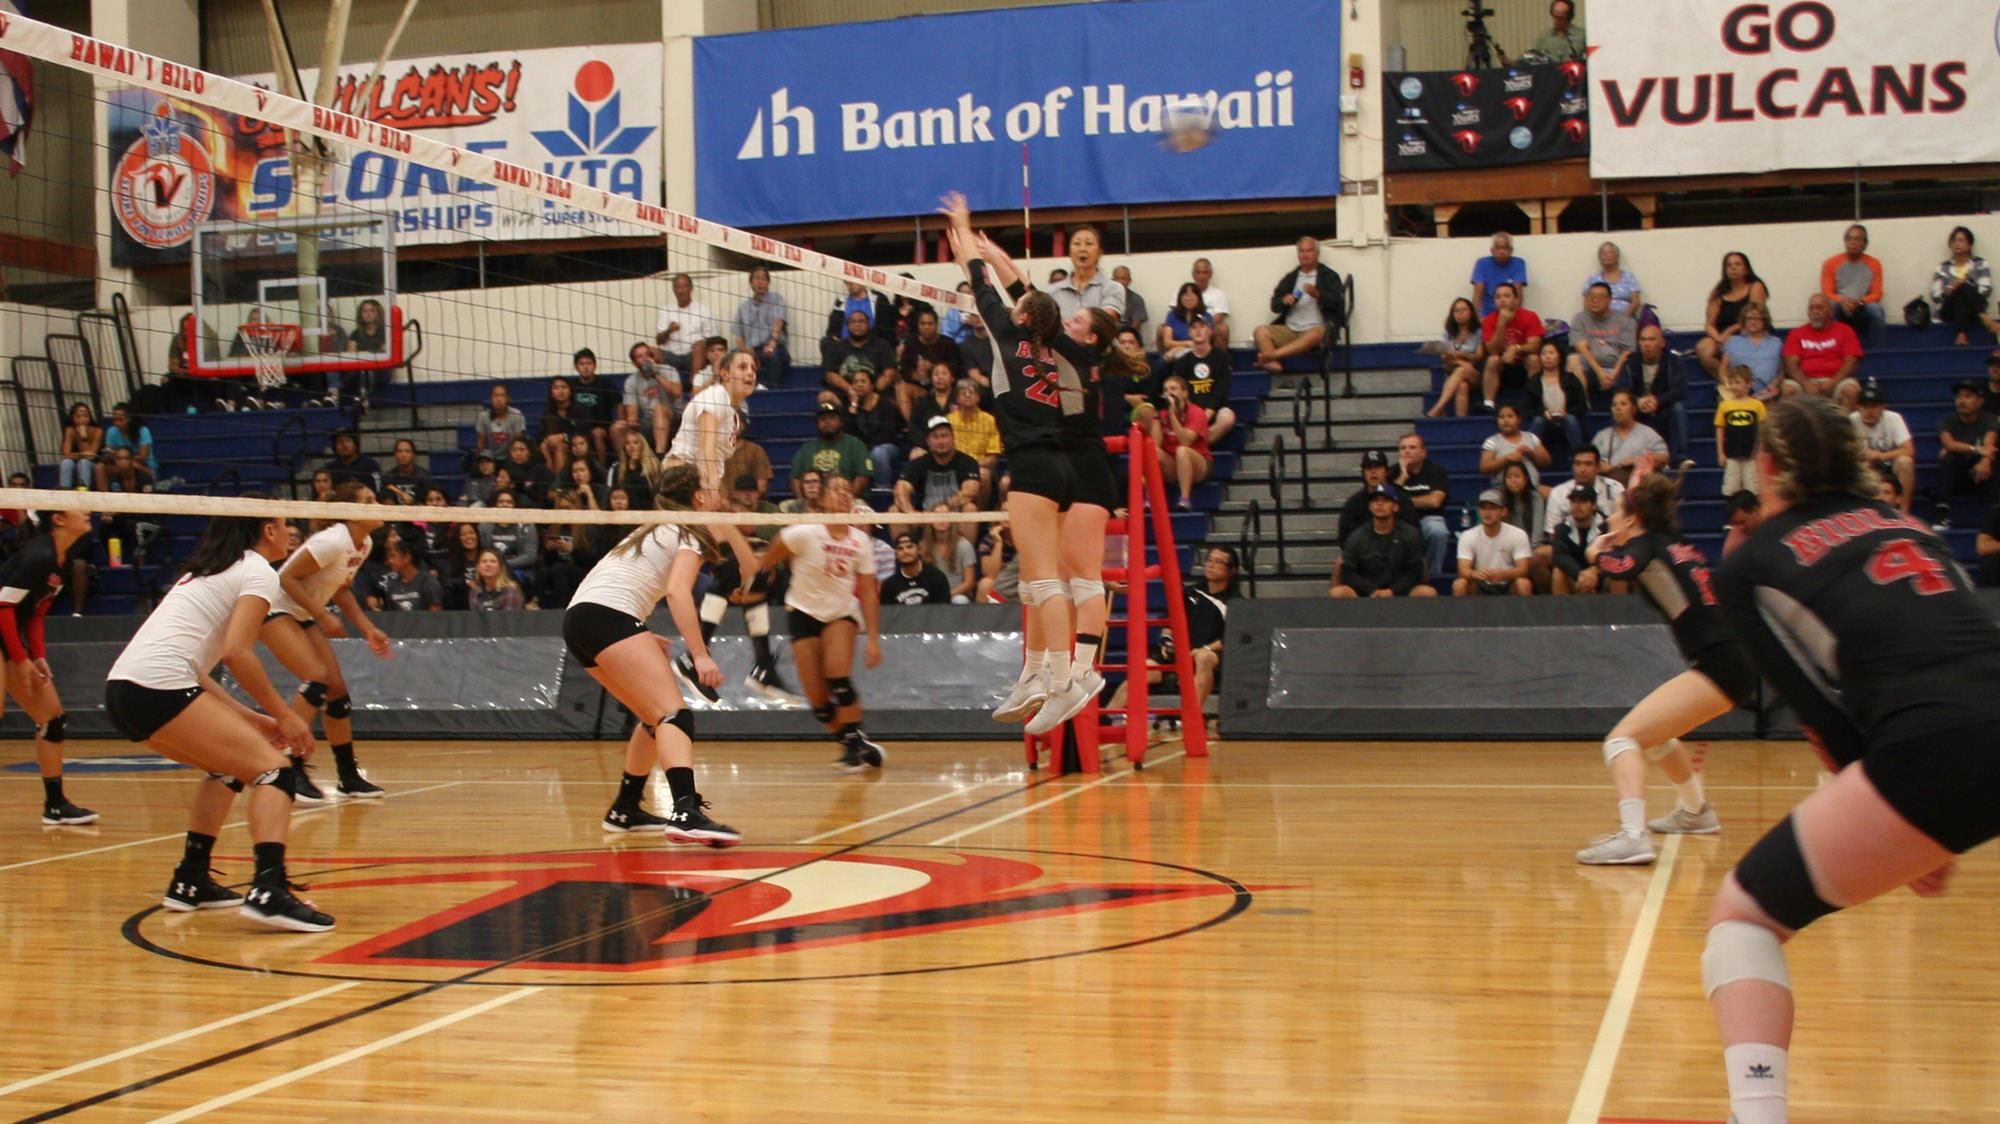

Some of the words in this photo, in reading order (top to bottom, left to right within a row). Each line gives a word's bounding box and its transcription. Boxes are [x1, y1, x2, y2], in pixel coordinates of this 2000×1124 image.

[1722, 0, 1836, 55] GO
[161, 61, 205, 95] HILO
[1600, 60, 1968, 129] VULCANS
[840, 93, 995, 152] Bank
[1005, 86, 1074, 142] of
[1083, 69, 1295, 136] Hawaii
[545, 158, 643, 208] KTA
[543, 211, 587, 226] SUPER
[1863, 538, 1956, 595] 4
